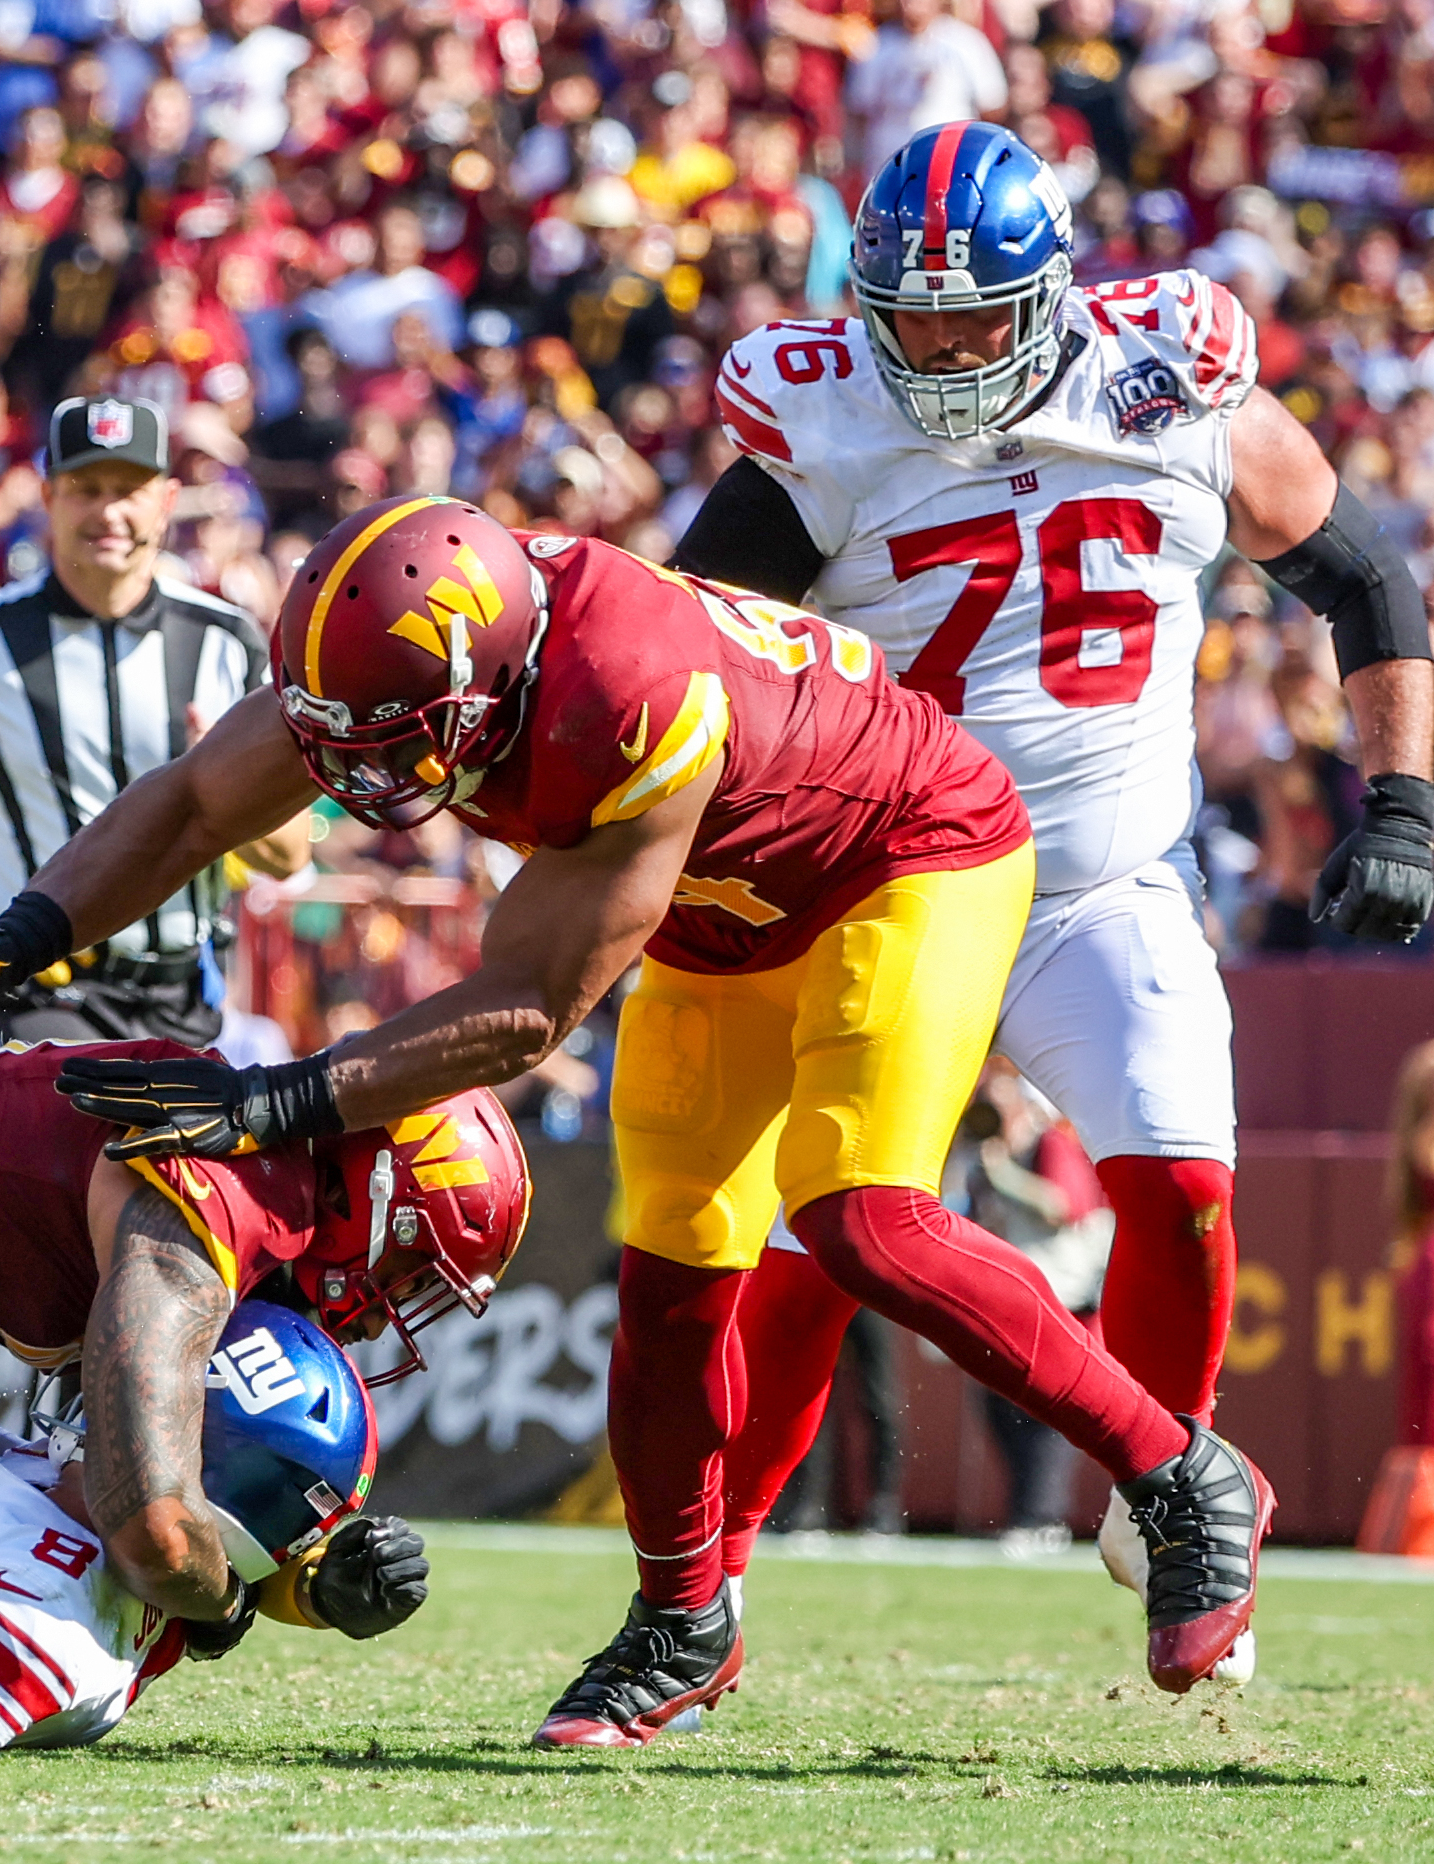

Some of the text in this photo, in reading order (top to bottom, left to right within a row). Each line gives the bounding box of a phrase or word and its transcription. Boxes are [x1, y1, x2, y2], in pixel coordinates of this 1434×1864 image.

[902, 229, 972, 269] 76
[886, 498, 1163, 716] 76
[348, 1283, 619, 1453] DERS
[31, 1527, 99, 1580] 8
